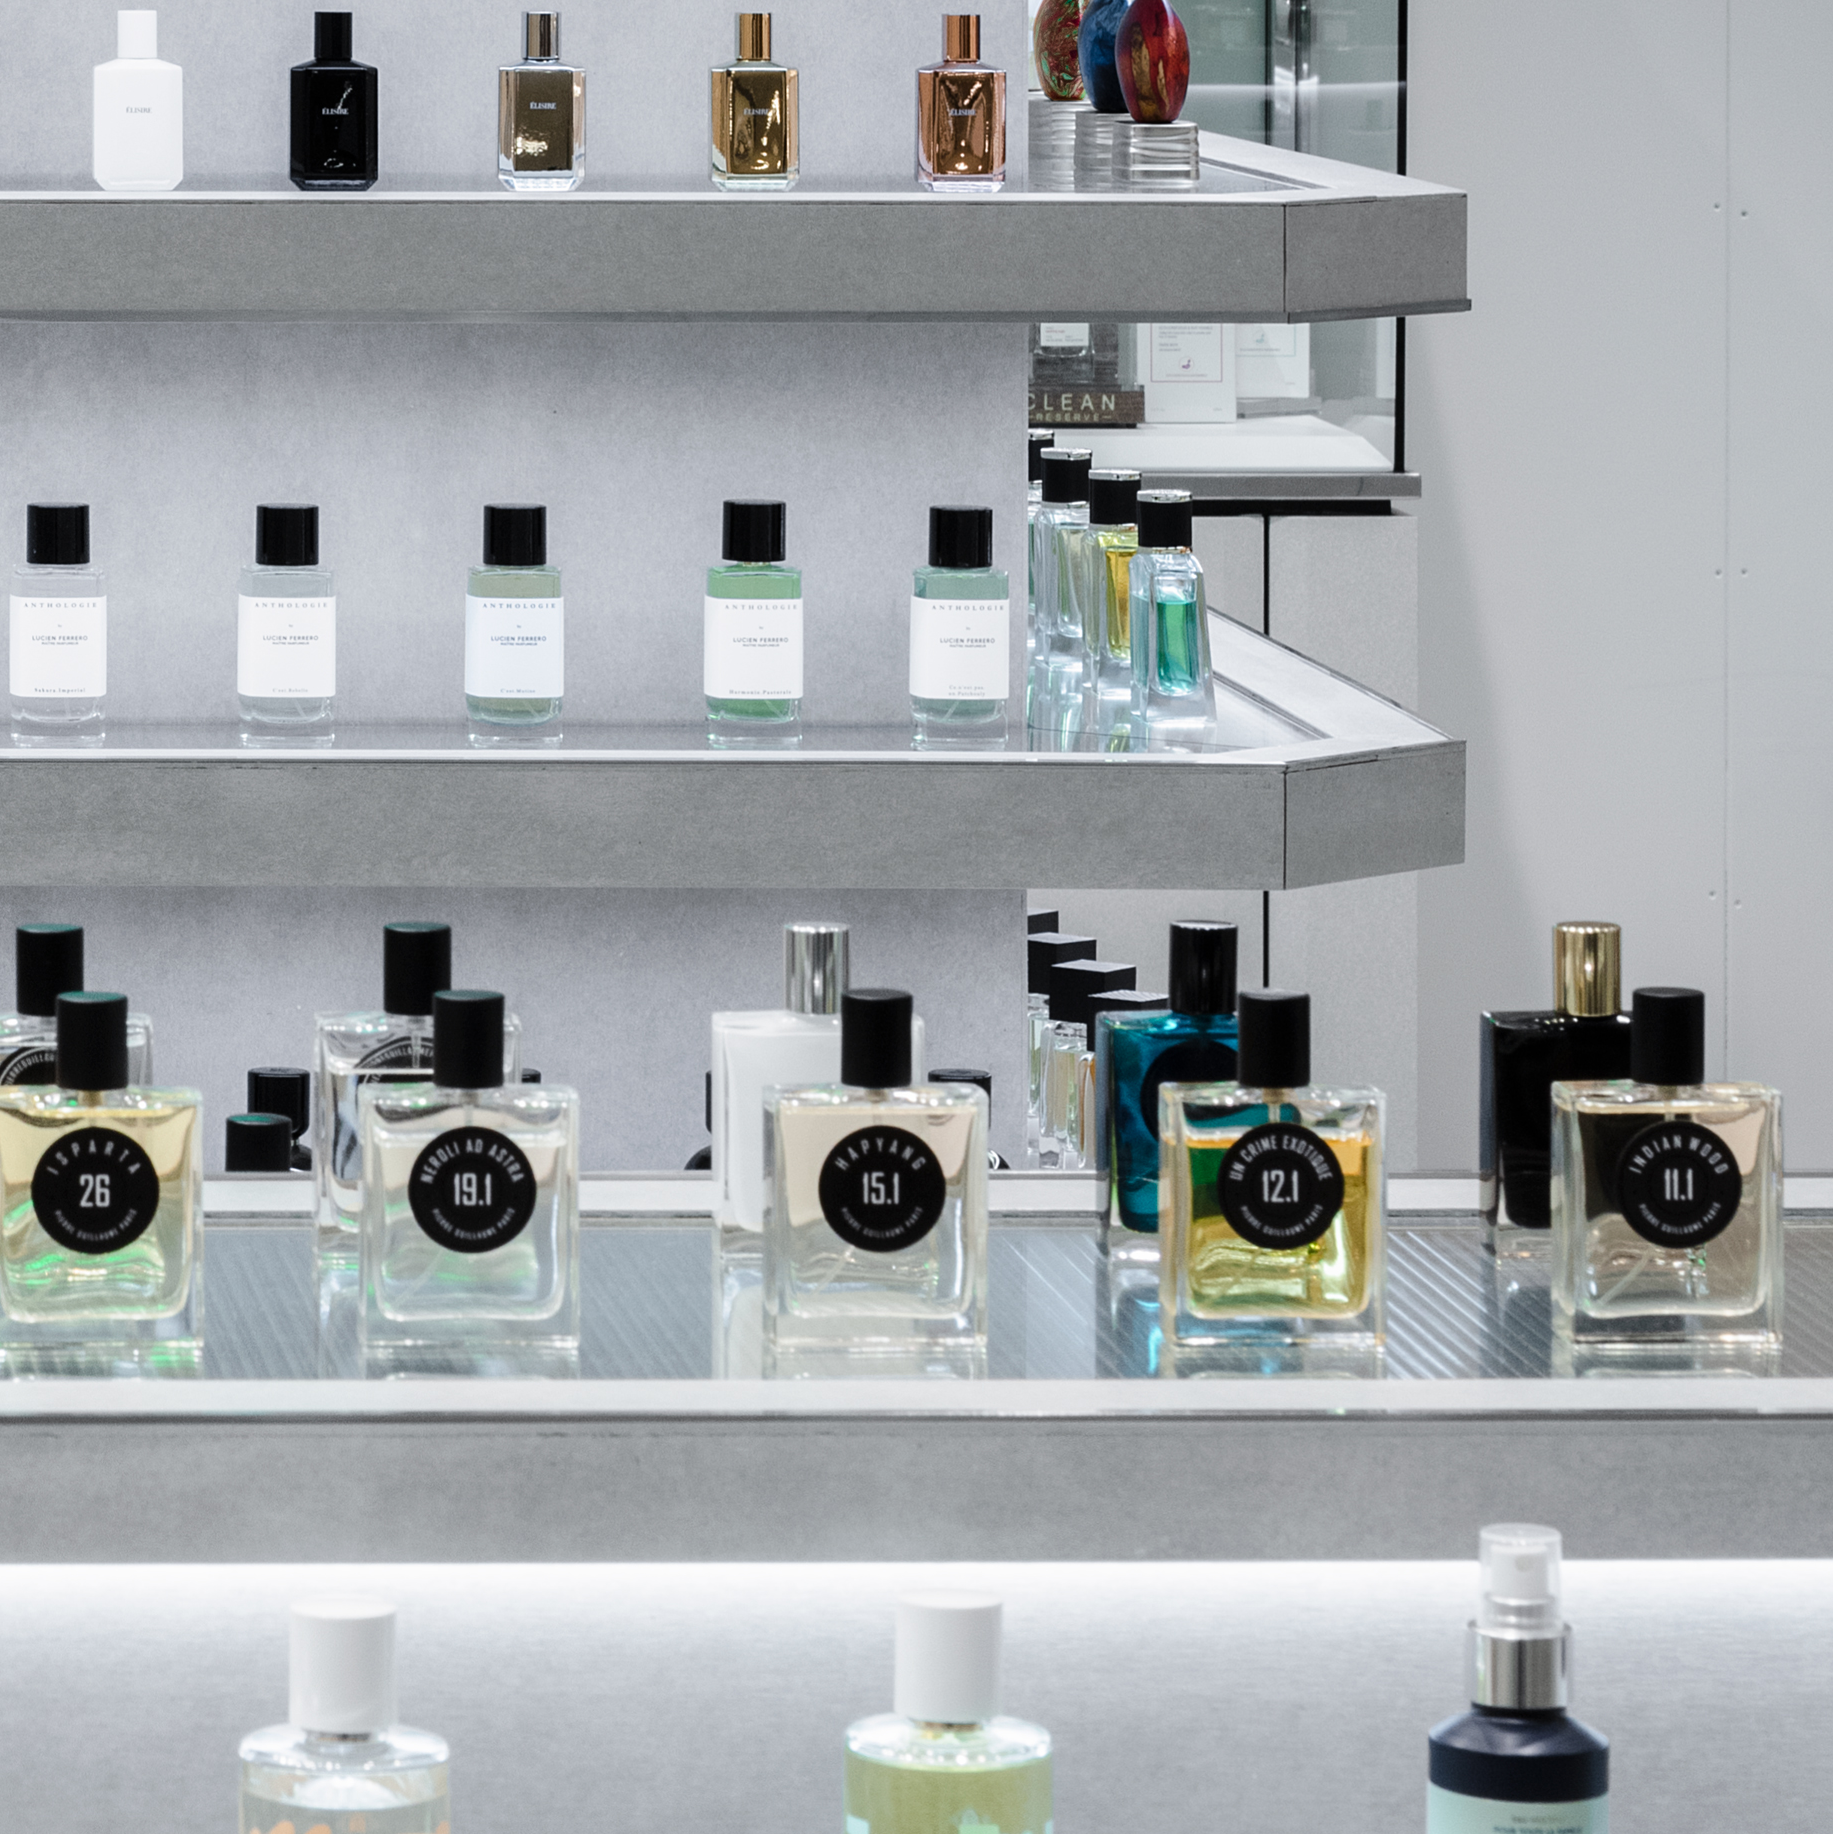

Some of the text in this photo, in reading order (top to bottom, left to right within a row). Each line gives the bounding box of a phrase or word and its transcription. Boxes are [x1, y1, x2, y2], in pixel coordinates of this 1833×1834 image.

[46, 1139, 142, 1176] ISPARTA
[420, 1138, 526, 1185] NEROLI AD ASTRA
[835, 1137, 927, 1171] HAPYANG
[1229, 1135, 1334, 1182] UN CRIME EXOTIQUE
[1629, 1135, 1731, 1175] INDIAN WOOD
[79, 1173, 111, 1208] 26
[454, 1172, 492, 1206] 19.1
[862, 1171, 900, 1206] 15.1
[1262, 1169, 1299, 1203] 12.1
[1664, 1168, 1694, 1201] 11.1
